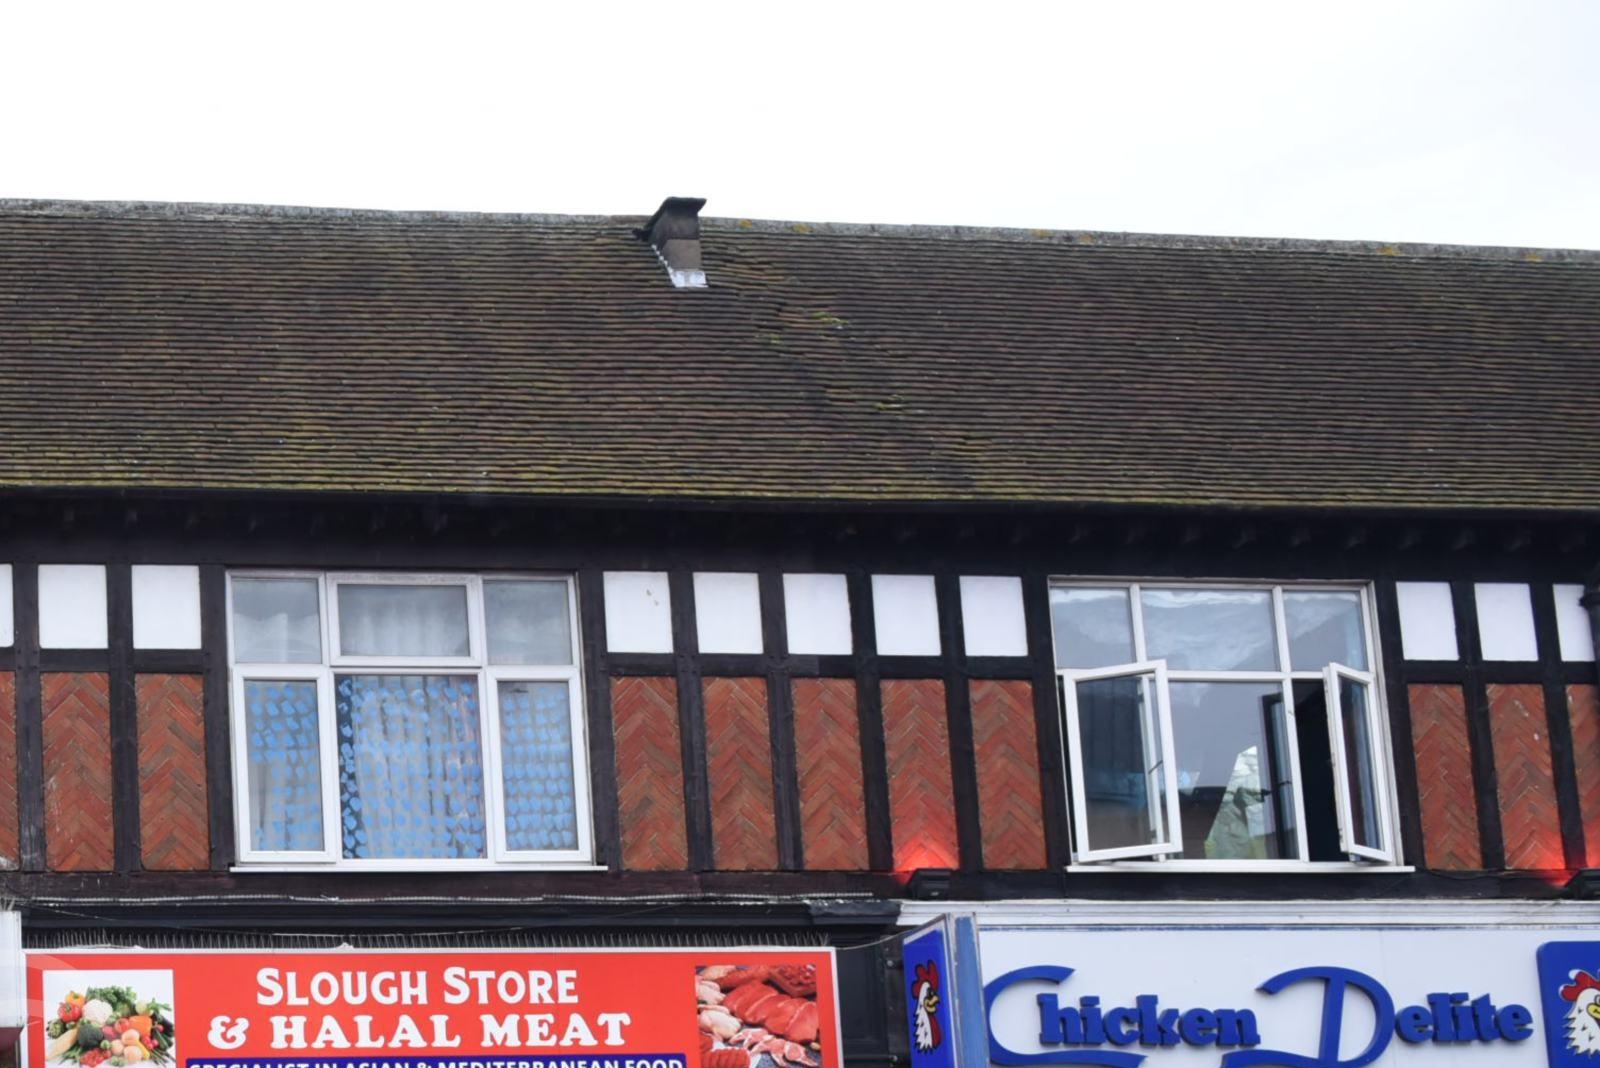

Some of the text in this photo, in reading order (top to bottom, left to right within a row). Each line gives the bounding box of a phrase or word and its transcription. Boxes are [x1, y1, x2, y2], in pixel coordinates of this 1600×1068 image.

[256, 967, 578, 1005] SLOUGH STORE
[207, 1013, 631, 1049] & HALAL MEAT
